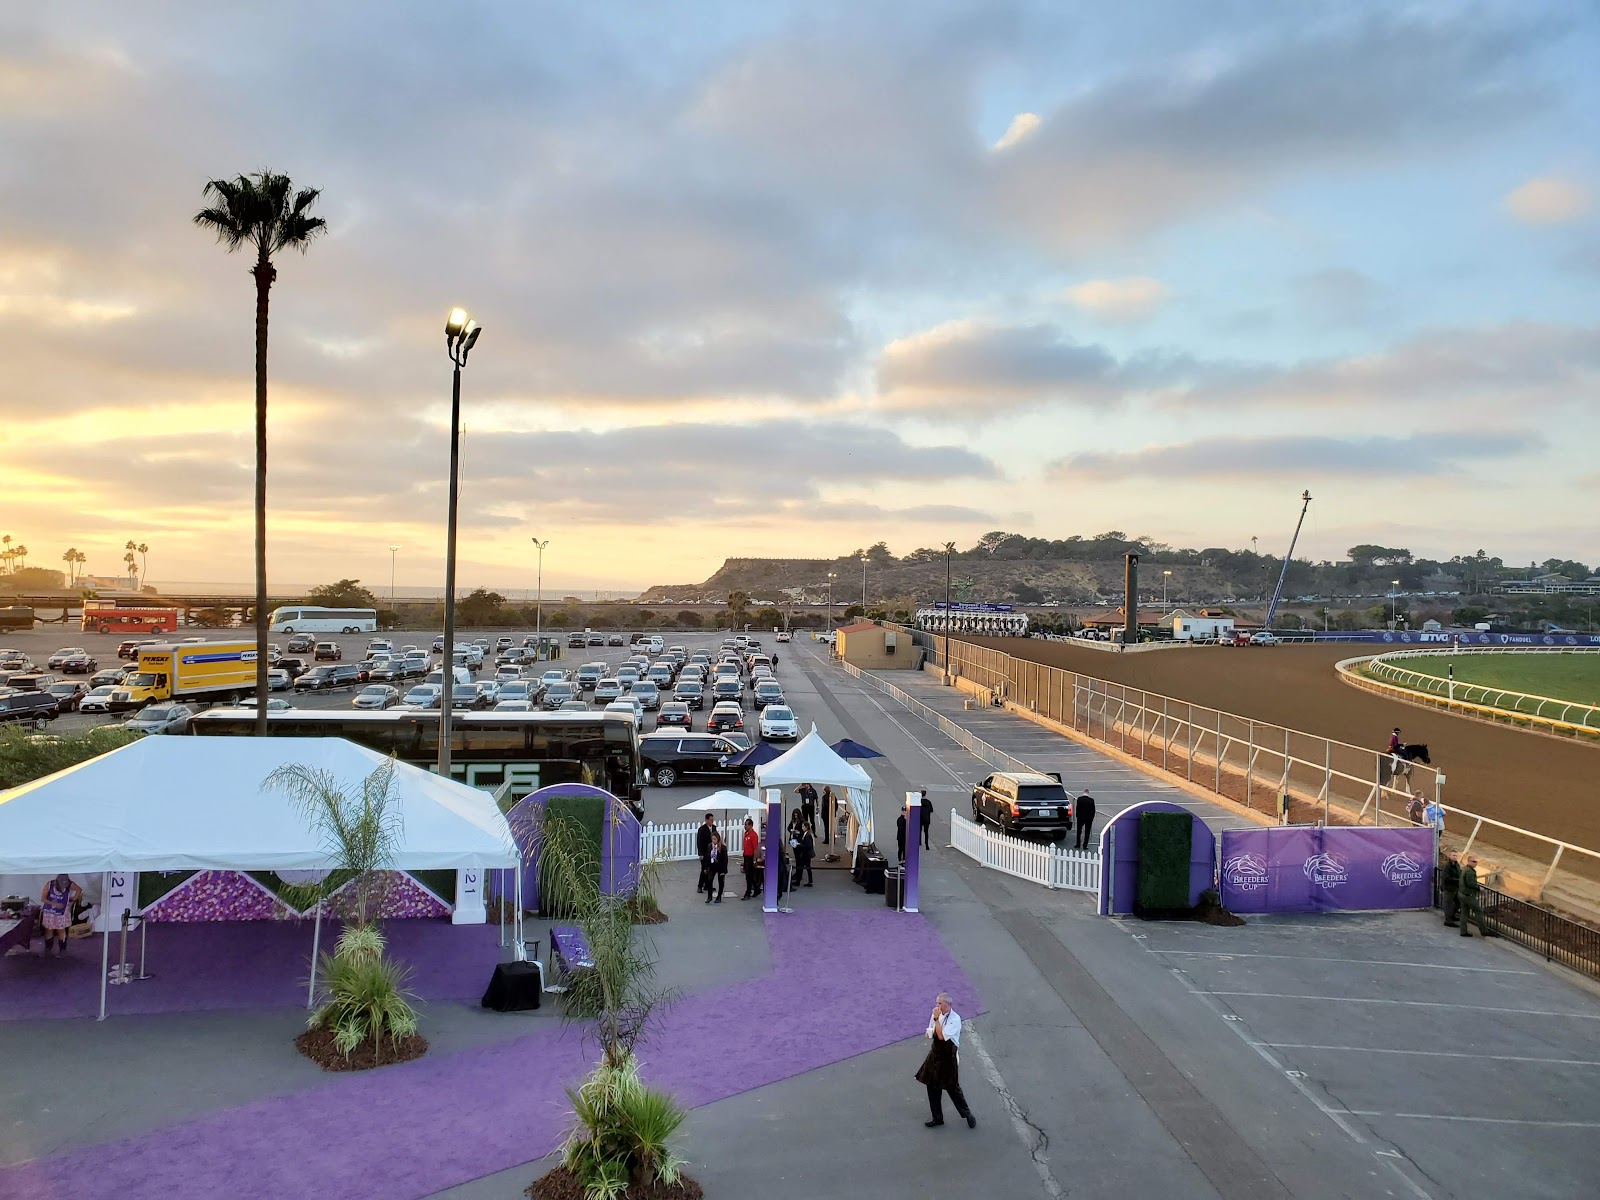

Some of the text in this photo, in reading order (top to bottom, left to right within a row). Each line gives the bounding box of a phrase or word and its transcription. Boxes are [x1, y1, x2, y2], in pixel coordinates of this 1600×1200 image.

[1429, 634, 1449, 642] TVG
[1233, 875, 1270, 883] BREEDERS'
[1314, 873, 1348, 882] BREEDERS'
[1391, 871, 1423, 880] BREEDERS'
[1242, 882, 1258, 891] CUP
[1321, 881, 1337, 889] CUP
[1399, 879, 1412, 887] CUP
